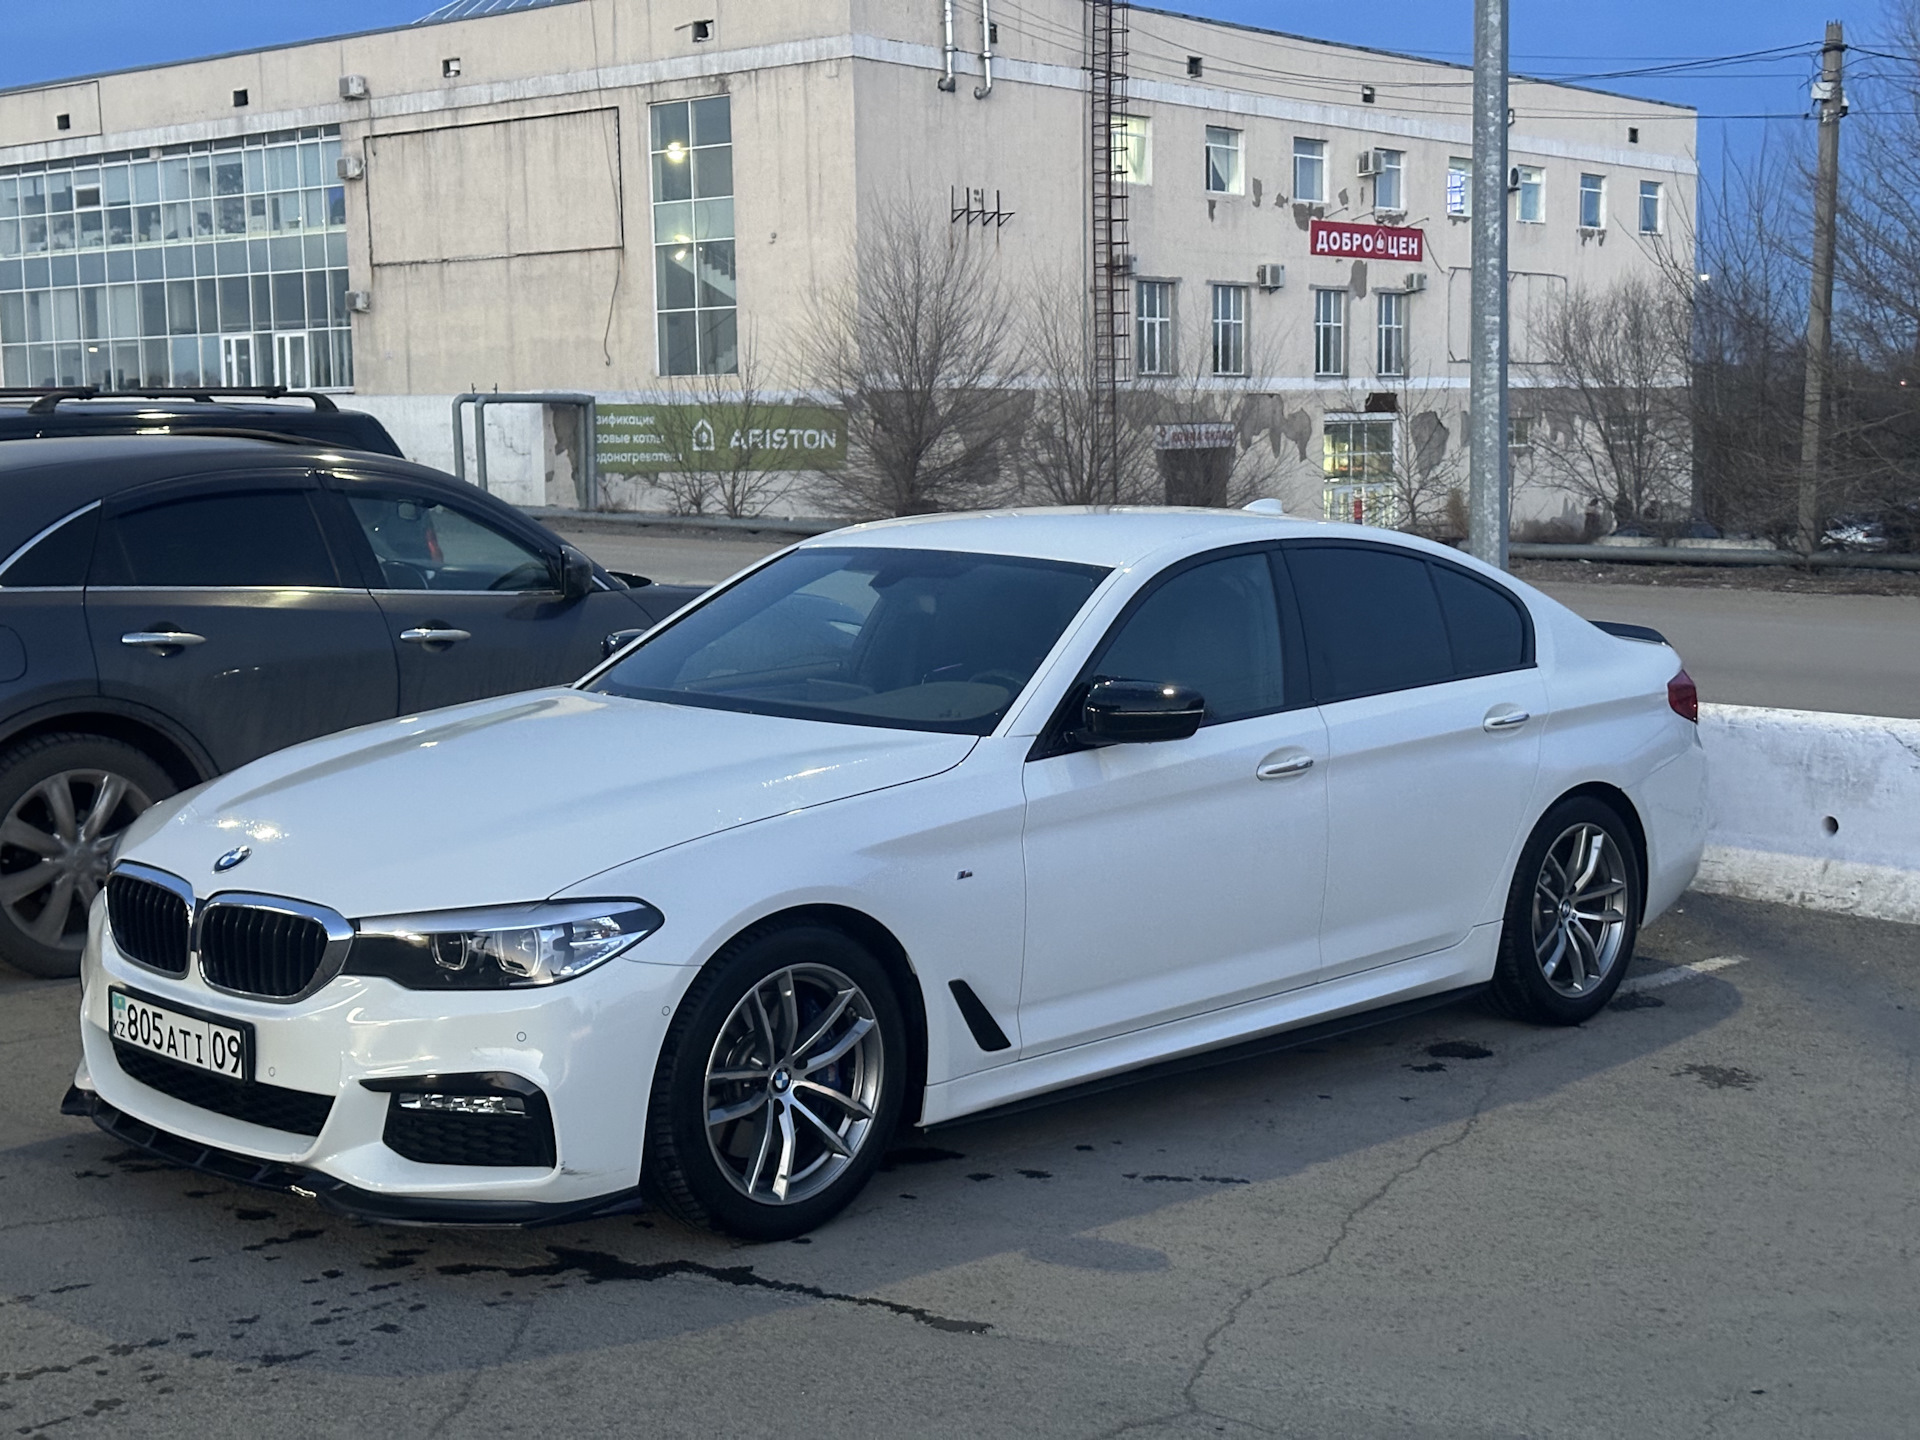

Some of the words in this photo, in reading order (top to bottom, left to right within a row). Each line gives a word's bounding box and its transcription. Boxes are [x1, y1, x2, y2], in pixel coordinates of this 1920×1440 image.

[1316, 230, 1373, 253] ДОБРО
[1387, 235, 1418, 258] ЦЕН
[729, 428, 837, 450] ARISTON
[112, 1018, 126, 1038] KZ
[212, 1031, 242, 1074] 09
